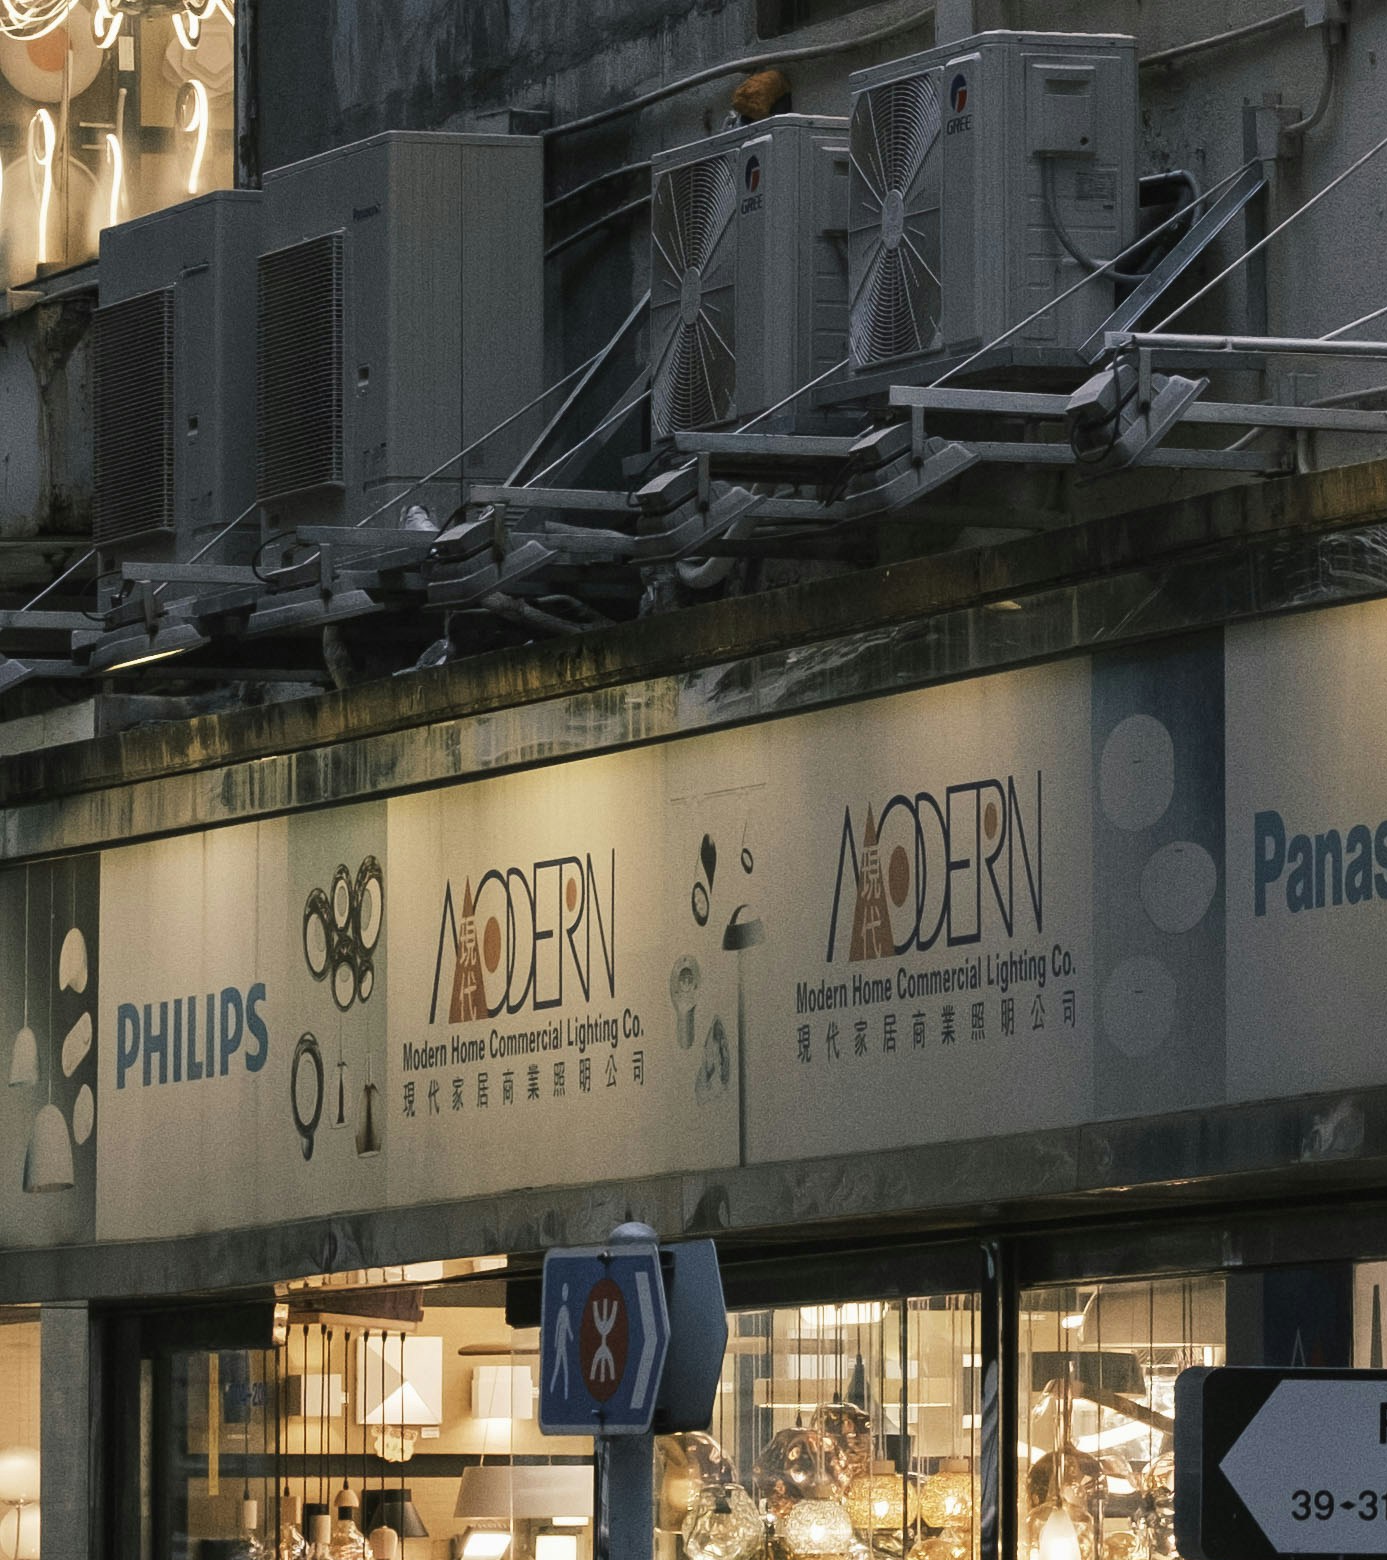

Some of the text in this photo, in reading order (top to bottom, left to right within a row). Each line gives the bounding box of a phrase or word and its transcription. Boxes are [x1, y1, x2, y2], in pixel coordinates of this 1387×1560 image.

[826, 770, 1042, 963] MODERN
[429, 848, 615, 1024] MODERN
[796, 944, 1076, 1014] Modern Home Commercial Lighting Co.
[117, 983, 268, 1090] PHILIPS
[403, 1008, 644, 1072] Modern Home Commercial Lighting Co.
[797, 990, 1076, 1064] 現代家居商業照明公司
[403, 1049, 645, 1119] 現代家居商業照明公司
